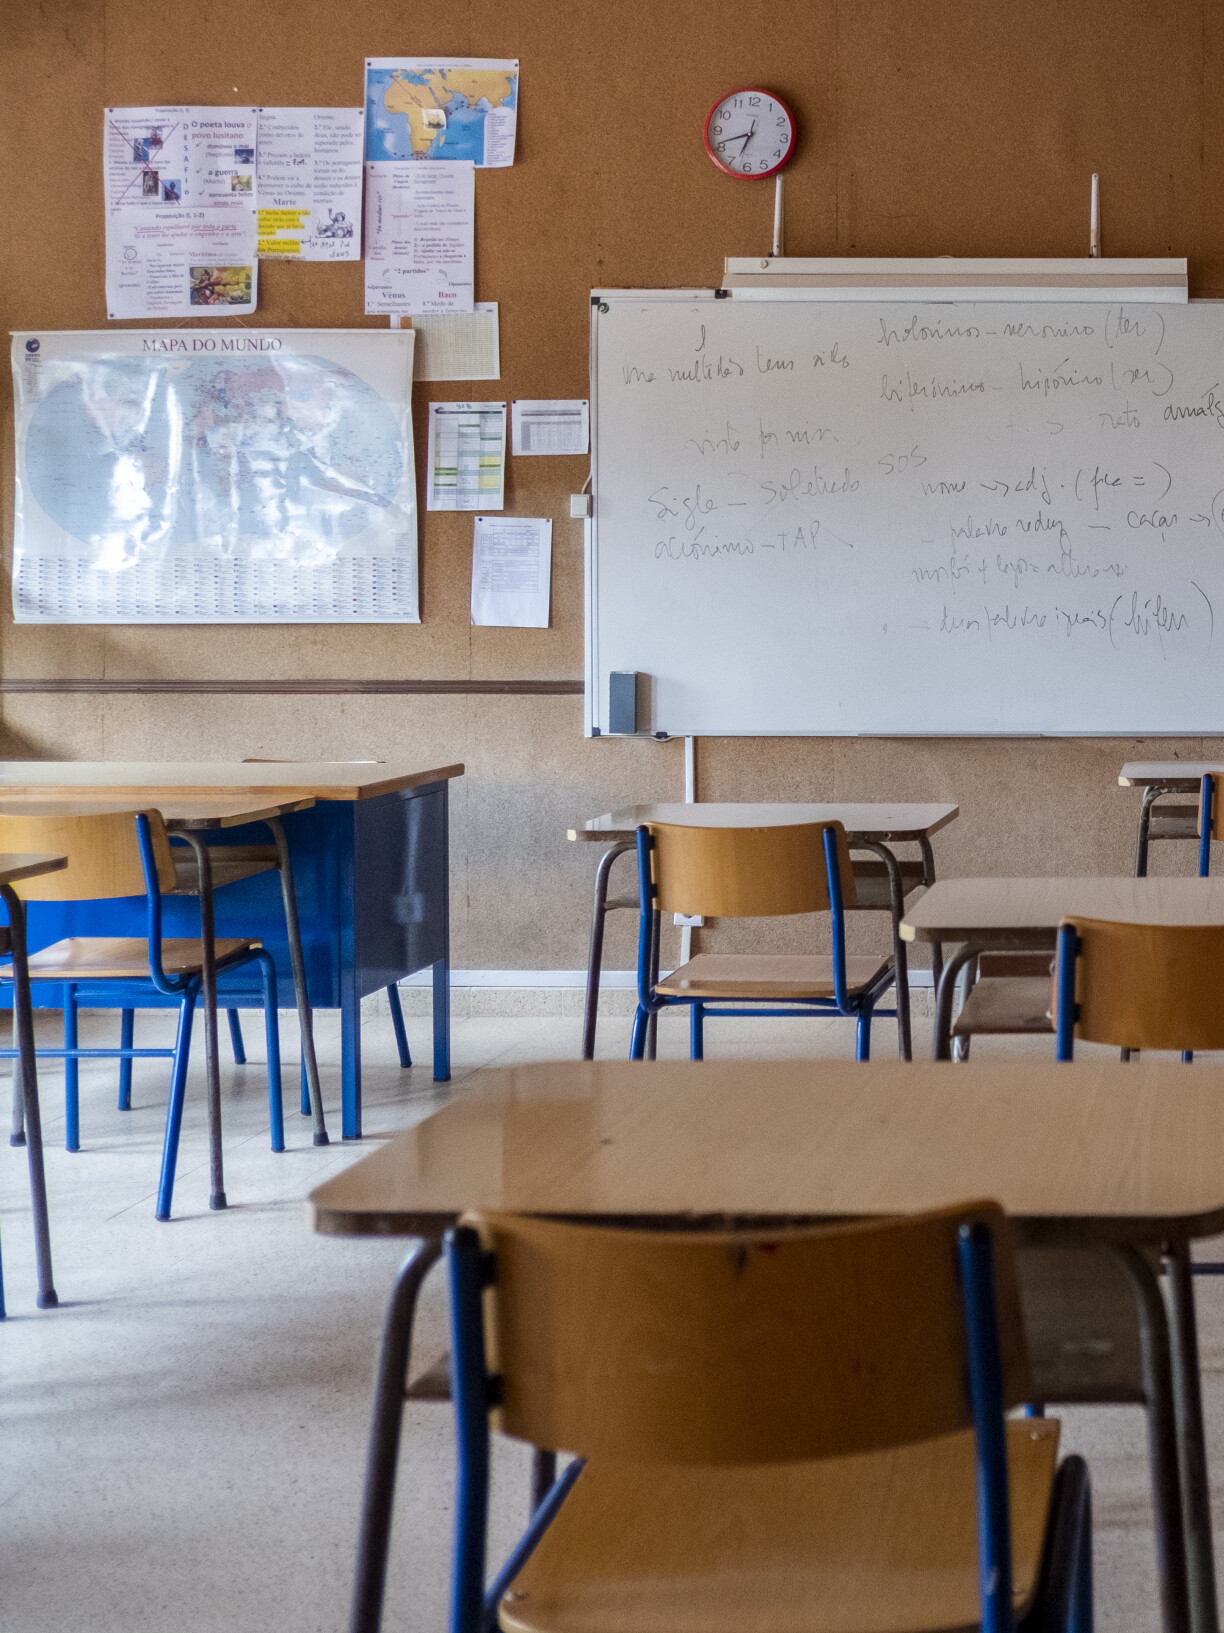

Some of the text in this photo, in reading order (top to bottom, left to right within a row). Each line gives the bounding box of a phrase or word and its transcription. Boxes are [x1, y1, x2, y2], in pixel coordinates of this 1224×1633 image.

[734, 98, 743, 109] 11
[749, 96, 761, 107] 12
[769, 102, 774, 112] 1
[719, 109, 731, 120] 10
[199, 121, 222, 129] poeta
[224, 120, 245, 128] louva
[776, 117, 786, 127] 2
[213, 130, 243, 139] lusitano
[713, 126, 723, 136] 9
[780, 133, 789, 144] 3
[717, 142, 726, 153] 8
[773, 149, 781, 159] 4
[728, 155, 736, 166] 7
[760, 159, 769, 170] 5
[743, 162, 752, 173] 6
[214, 169, 239, 177] guerra
[273, 198, 297, 206] Marte
[382, 291, 406, 299] Vénus
[438, 291, 457, 299] Baco
[142, 338, 282, 351] MAPA DO MUNDO
